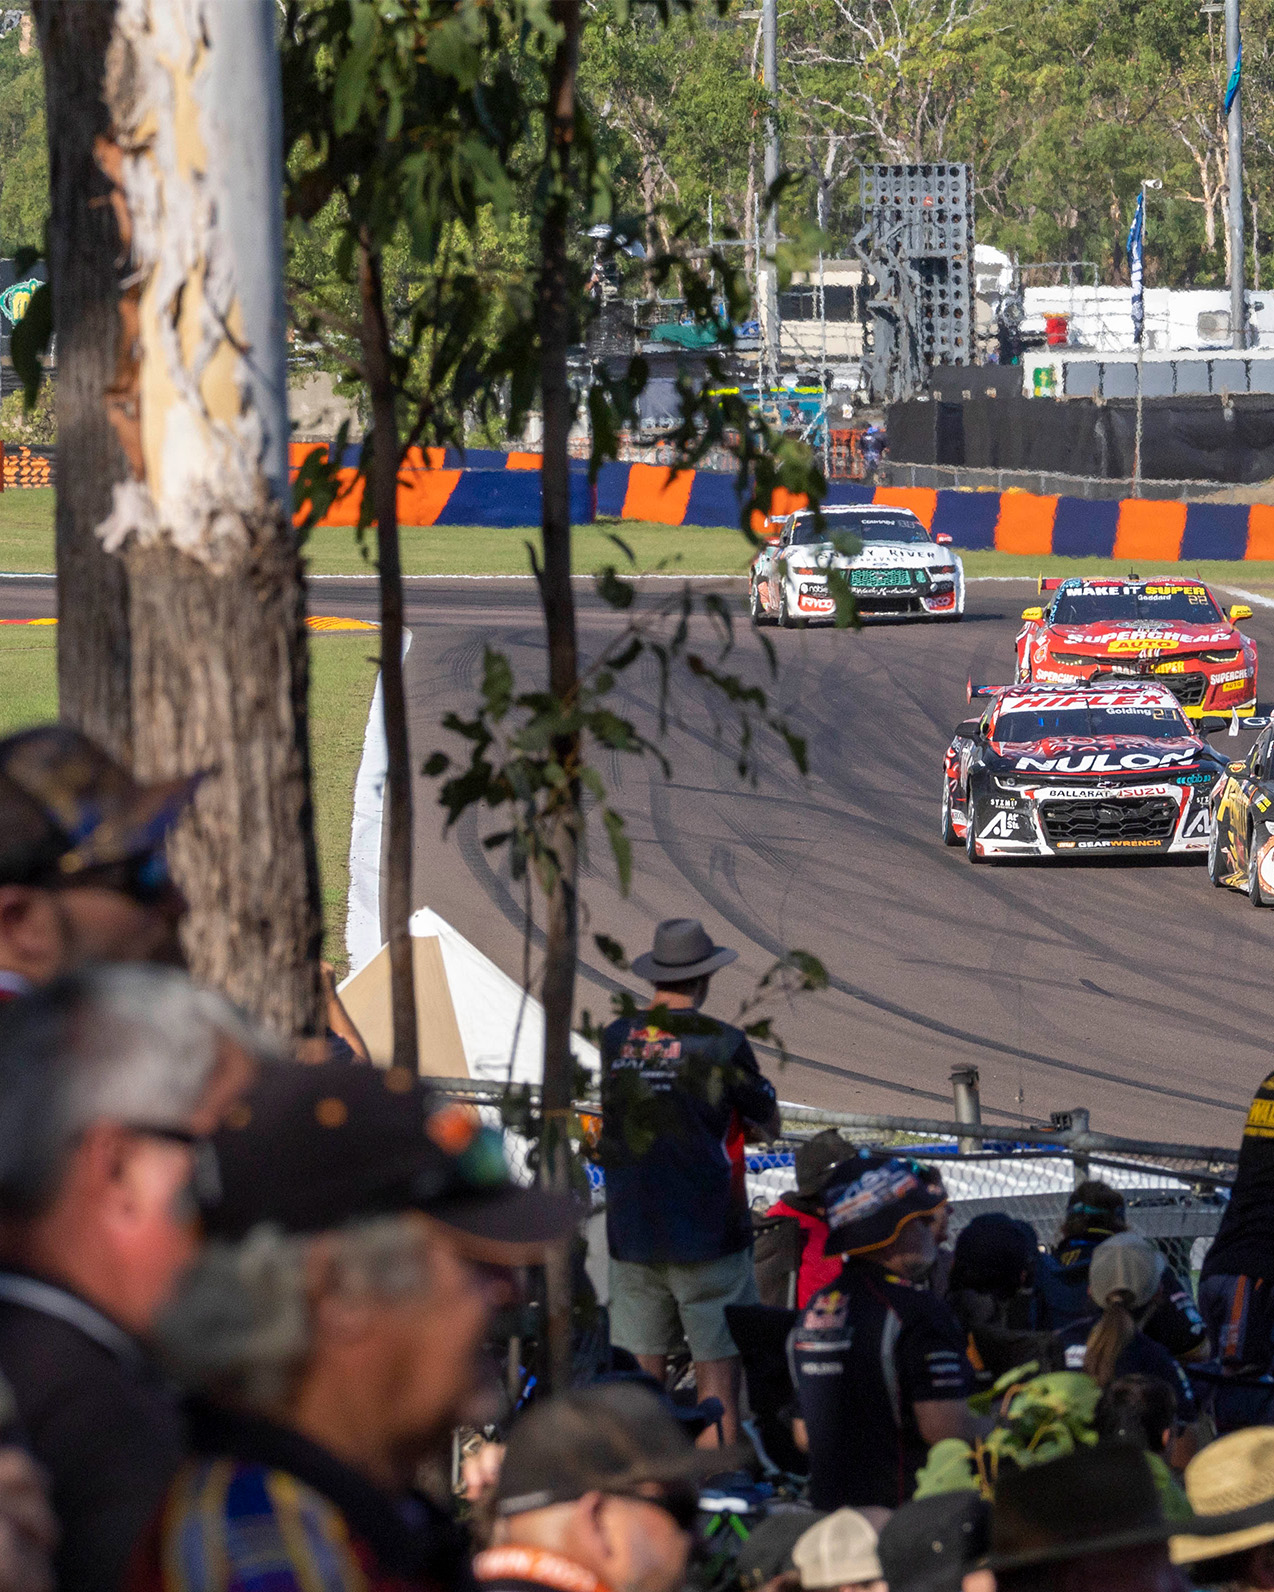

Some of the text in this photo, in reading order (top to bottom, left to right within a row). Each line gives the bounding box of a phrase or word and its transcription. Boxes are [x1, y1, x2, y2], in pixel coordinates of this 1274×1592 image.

[889, 549, 935, 559] RIVER
[1066, 586, 1206, 597] MAKE IT SUPER
[801, 597, 834, 609] RYCO
[1064, 631, 1232, 645] SUPERCHEAP
[1117, 640, 1173, 649] AUTO
[1225, 682, 1242, 690] AUTO
[1011, 695, 1162, 709] HIFLEX
[1106, 707, 1152, 716] Golding
[1015, 747, 1196, 772] NULON
[1050, 787, 1167, 798] BALLARAT ISUZU
[1078, 839, 1162, 849] GEARWRENCH
